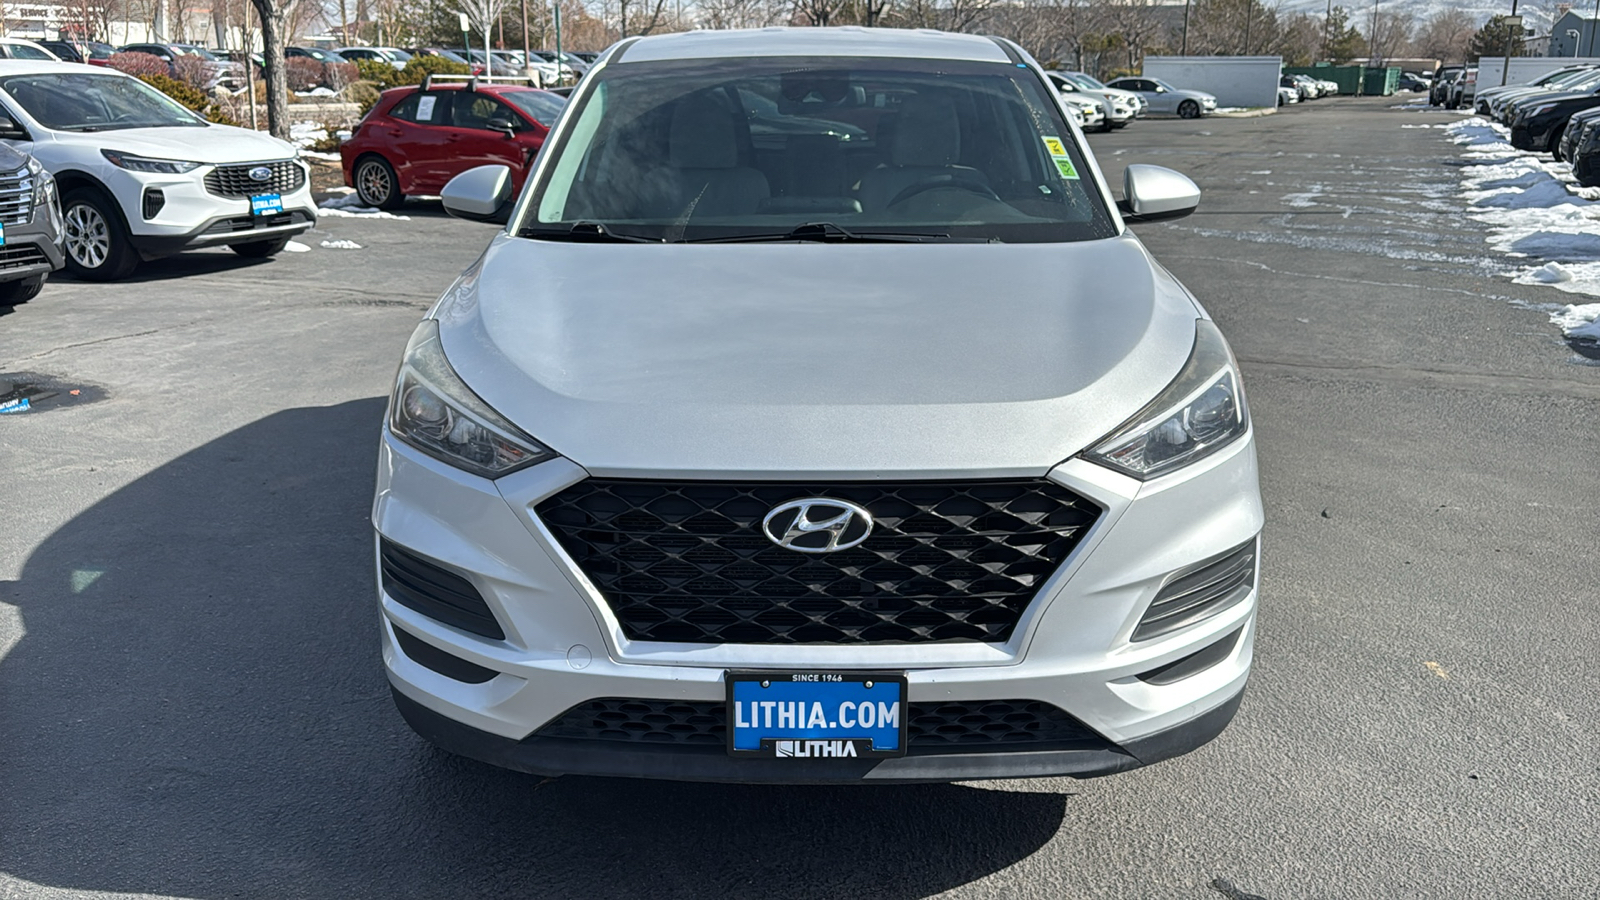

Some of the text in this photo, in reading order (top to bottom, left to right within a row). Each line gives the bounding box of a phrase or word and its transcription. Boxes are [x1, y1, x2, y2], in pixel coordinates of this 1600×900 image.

[792, 674, 843, 682] SINCE 1946
[734, 701, 900, 729] LITHIA.COM
[794, 740, 858, 758] LITHIA
